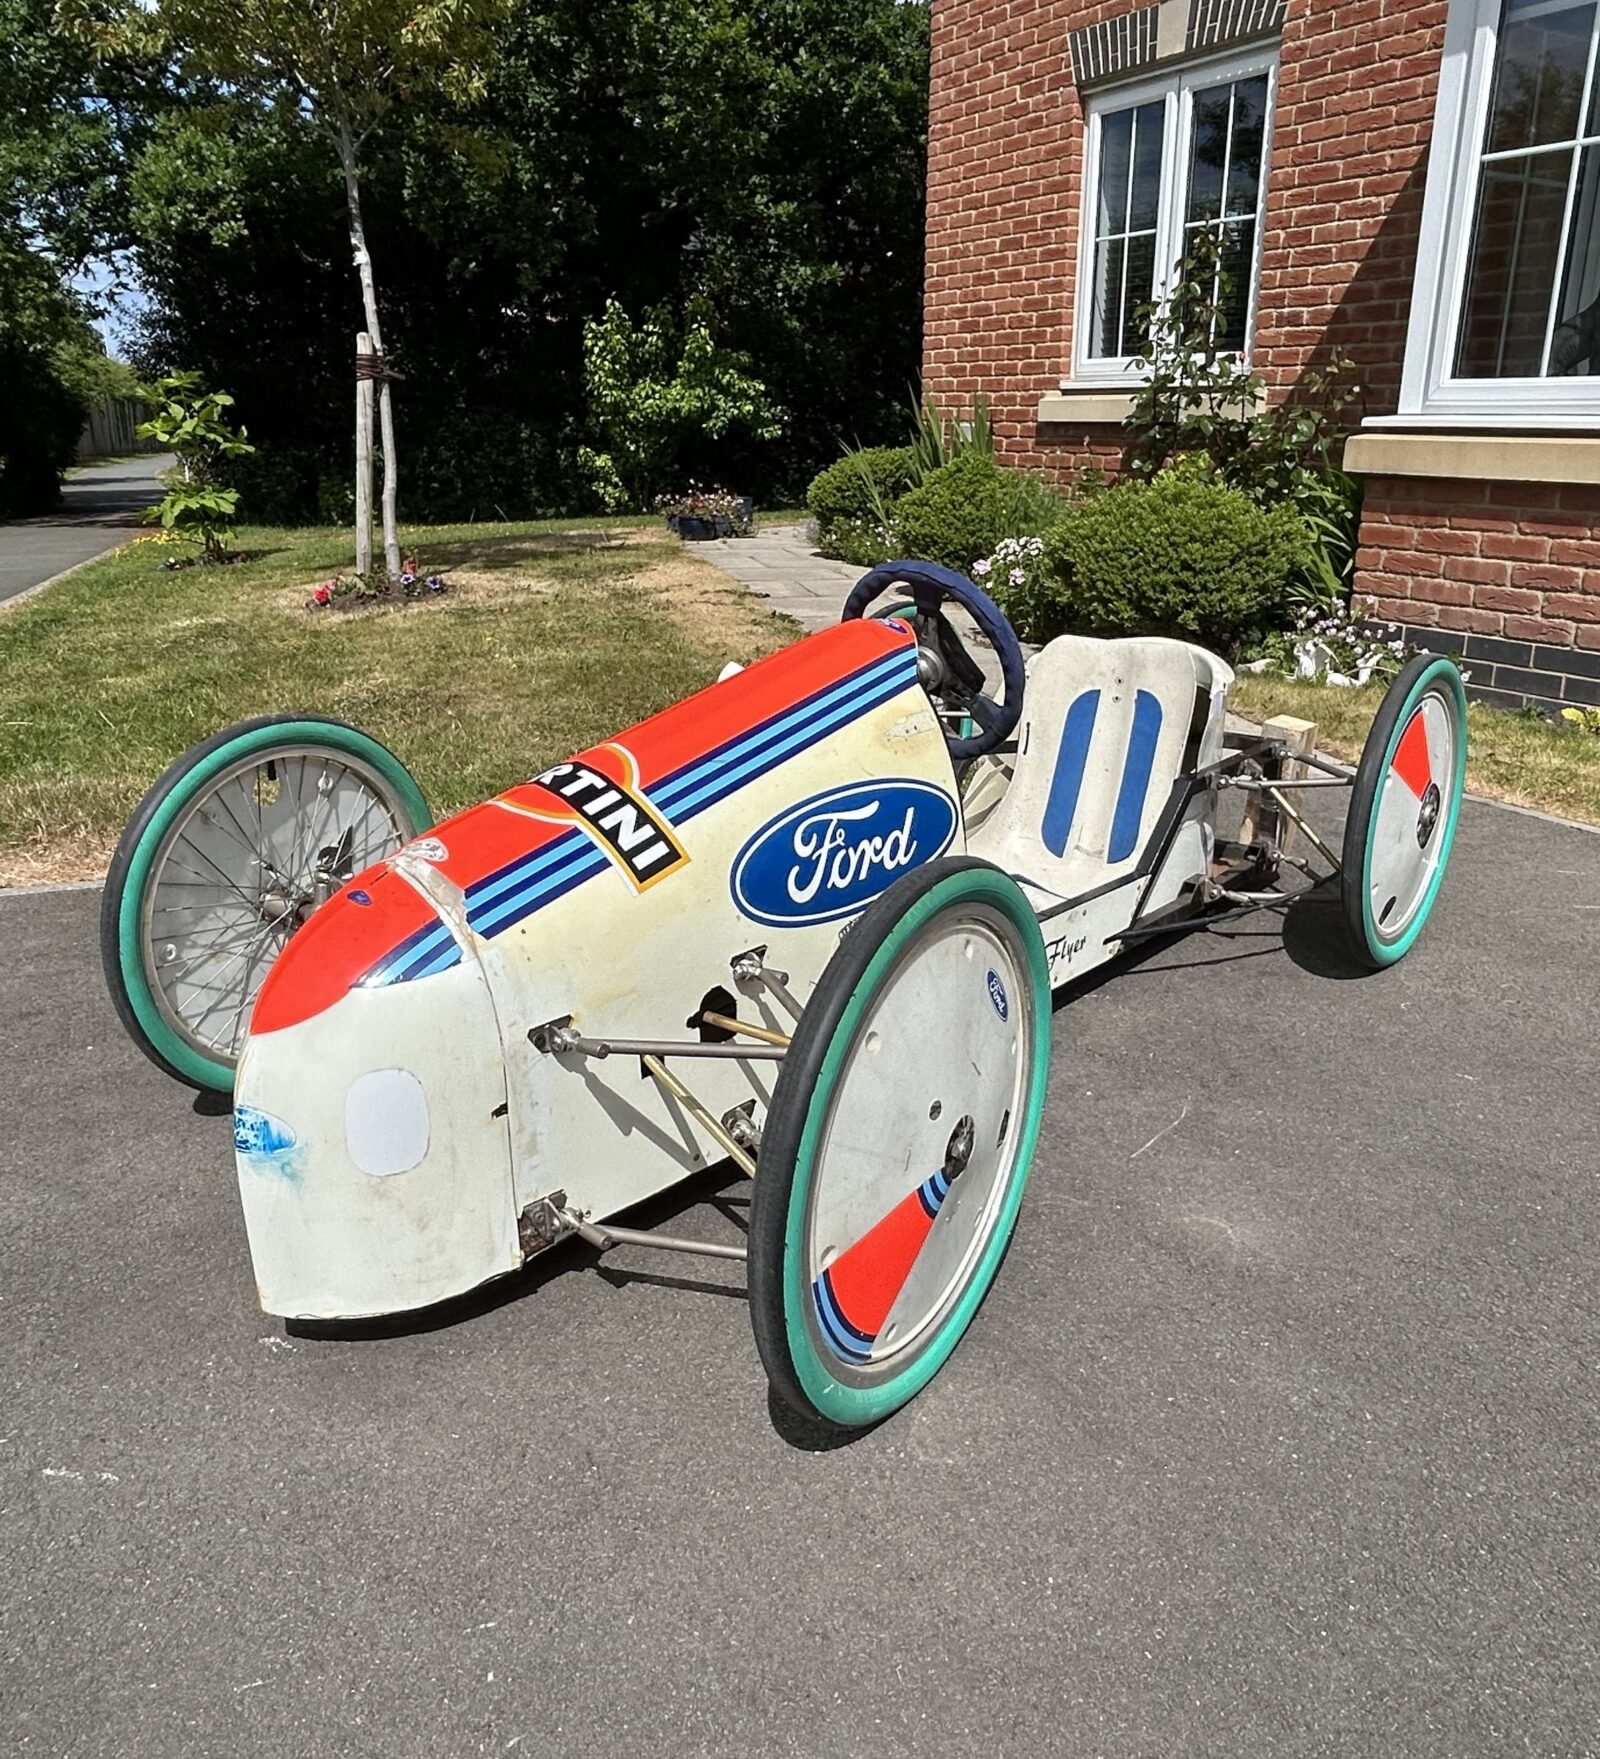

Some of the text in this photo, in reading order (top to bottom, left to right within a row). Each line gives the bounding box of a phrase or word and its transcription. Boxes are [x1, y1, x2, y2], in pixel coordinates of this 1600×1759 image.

[527, 763, 670, 871] RTINI
[787, 800, 917, 903] Ford
[1044, 935, 1086, 972] Flyer
[989, 977, 1006, 1013] Ford
